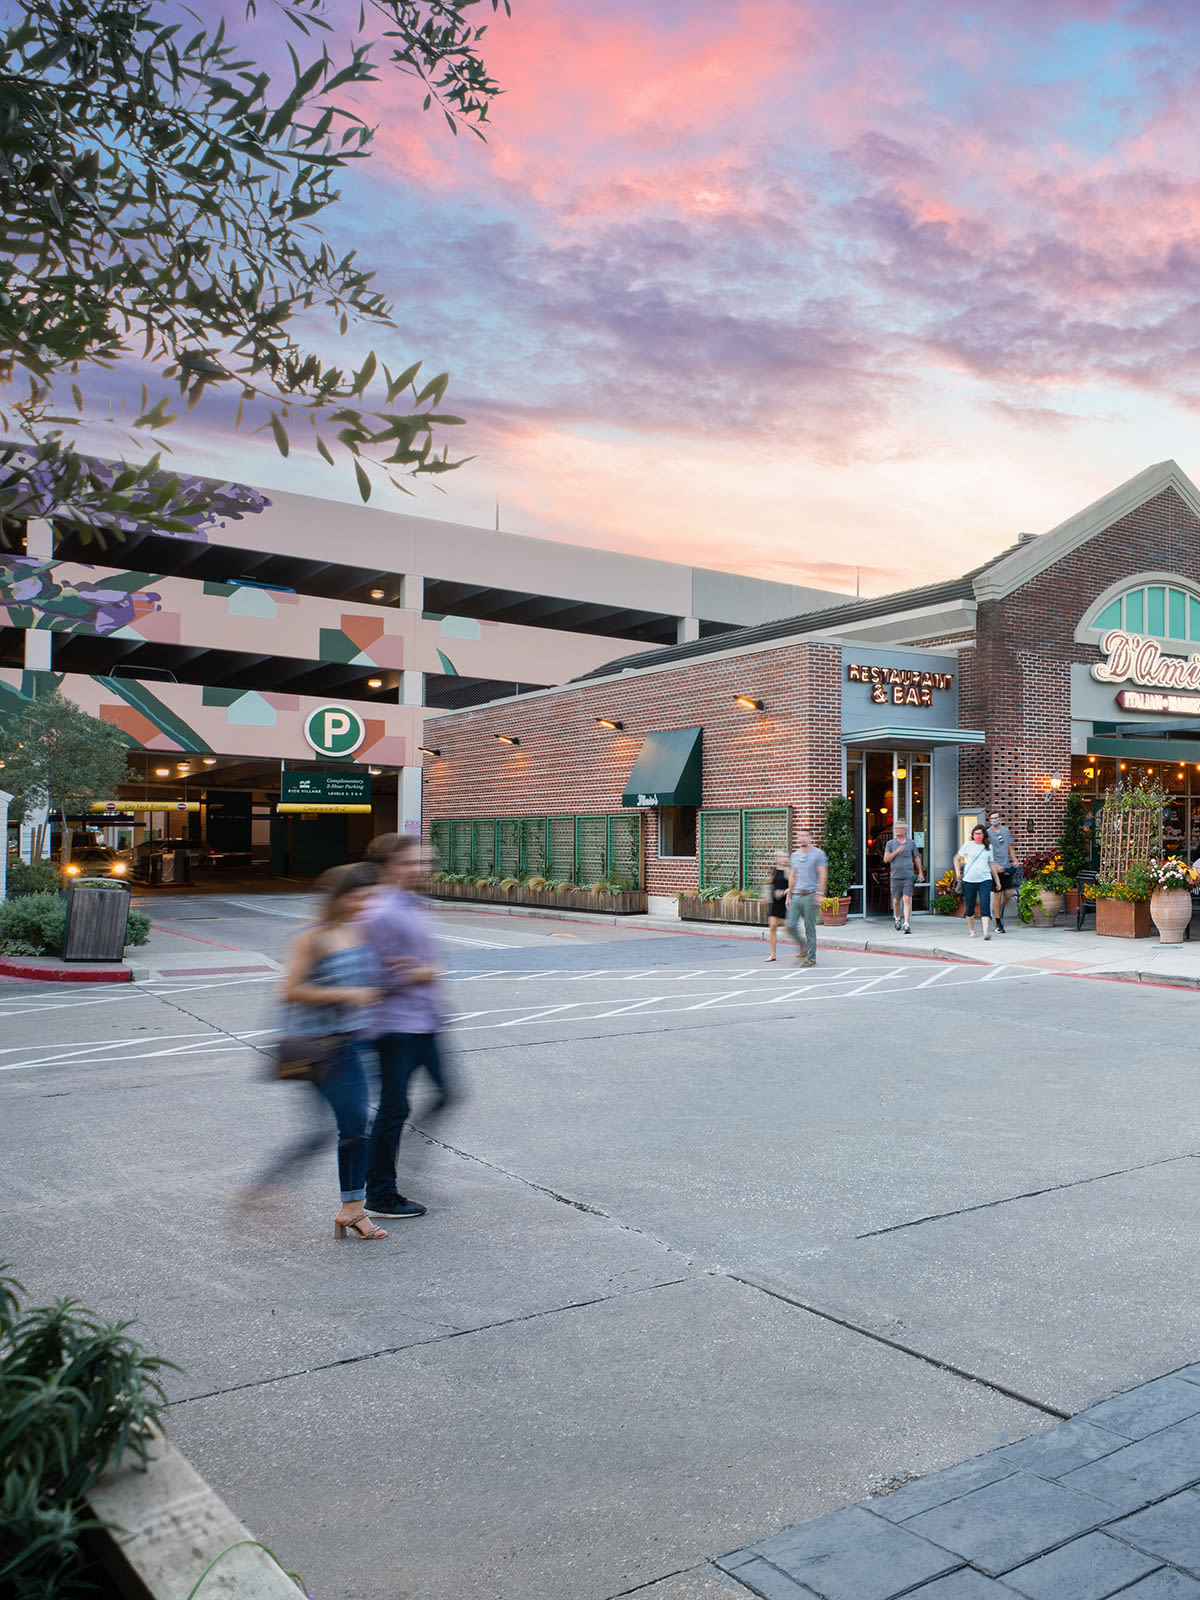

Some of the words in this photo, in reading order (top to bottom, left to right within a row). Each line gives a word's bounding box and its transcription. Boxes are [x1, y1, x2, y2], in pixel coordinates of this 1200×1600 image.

[848, 664, 954, 689] RESTAURANT
[873, 684, 887, 703] &
[892, 686, 933, 705] BAR
[324, 712, 350, 748] P
